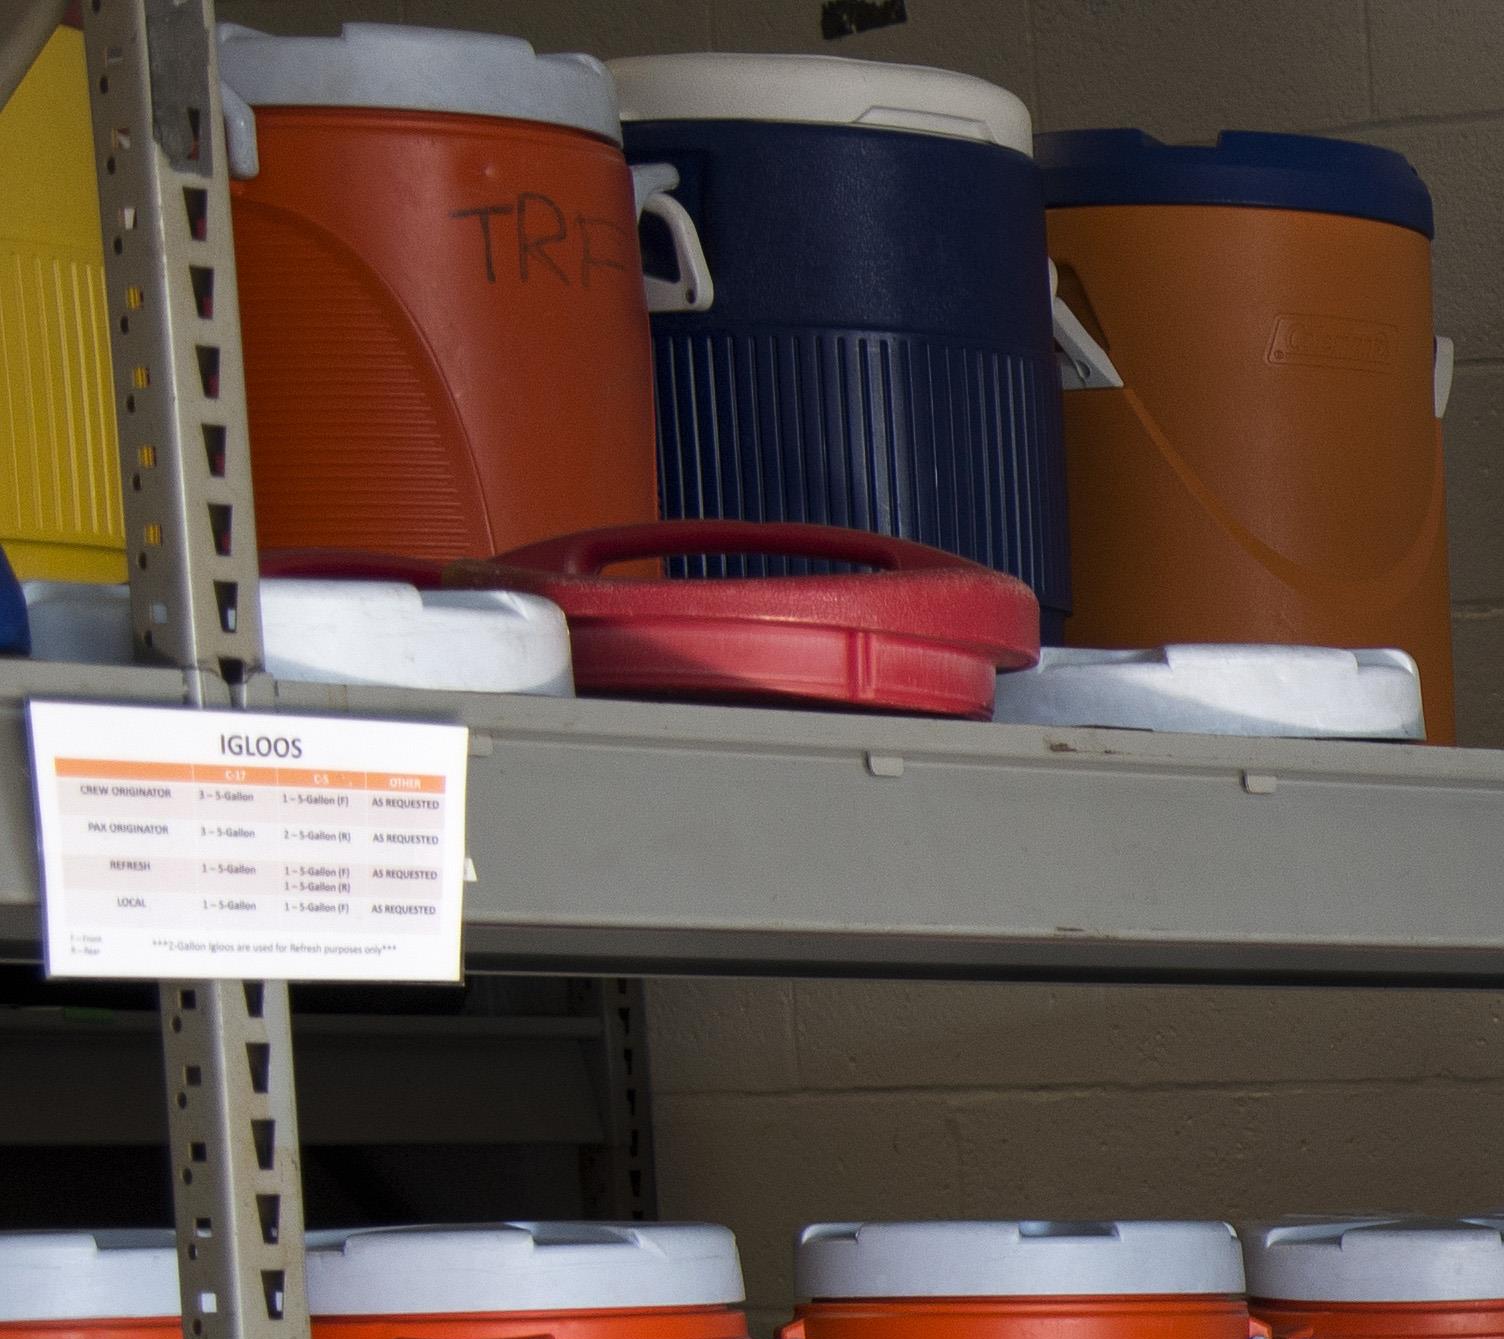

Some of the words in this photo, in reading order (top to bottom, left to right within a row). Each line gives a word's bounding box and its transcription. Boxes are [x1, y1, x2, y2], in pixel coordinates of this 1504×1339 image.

[219, 733, 303, 759] IGLOOS
[224, 769, 246, 781] C-17
[389, 778, 422, 790] OTHER
[80, 784, 109, 796] CREW
[112, 786, 172, 798] ORIGINATOR
[215, 791, 254, 803] 5-Gallon
[298, 795, 335, 806] 5-Gallon
[337, 796, 350, 808] (F)
[372, 797, 384, 807] AS
[385, 798, 440, 810] REQUESTED
[88, 822, 107, 833] PAX
[109, 823, 169, 835] ORIGINATOR
[216, 827, 255, 838] 5-Gallon
[299, 831, 336, 841] 5-Gallon
[338, 832, 351, 842] (R)
[373, 833, 385, 842] AS
[386, 834, 439, 846] REQUESTED
[110, 860, 151, 871] REFRESH
[217, 864, 256, 874] 5-Gallon
[299, 867, 336, 877] 5-Gallon
[339, 868, 350, 879] (F)
[372, 869, 384, 878] AS
[385, 870, 438, 881] REQUESTED
[299, 882, 336, 892] 5-Gallon
[338, 883, 351, 894] (R)
[117, 898, 147, 908] LOCAL
[218, 900, 256, 911] 5-Gallon
[299, 902, 336, 912] 5-Gallon
[338, 903, 349, 914] (F)
[371, 904, 383, 913] AS
[384, 905, 436, 916] REQUESTED
[236, 944, 250, 952] are
[252, 943, 274, 953] used
[275, 943, 287, 953] for
[290, 944, 322, 954] Refresh
[324, 945, 362, 956] purposes
